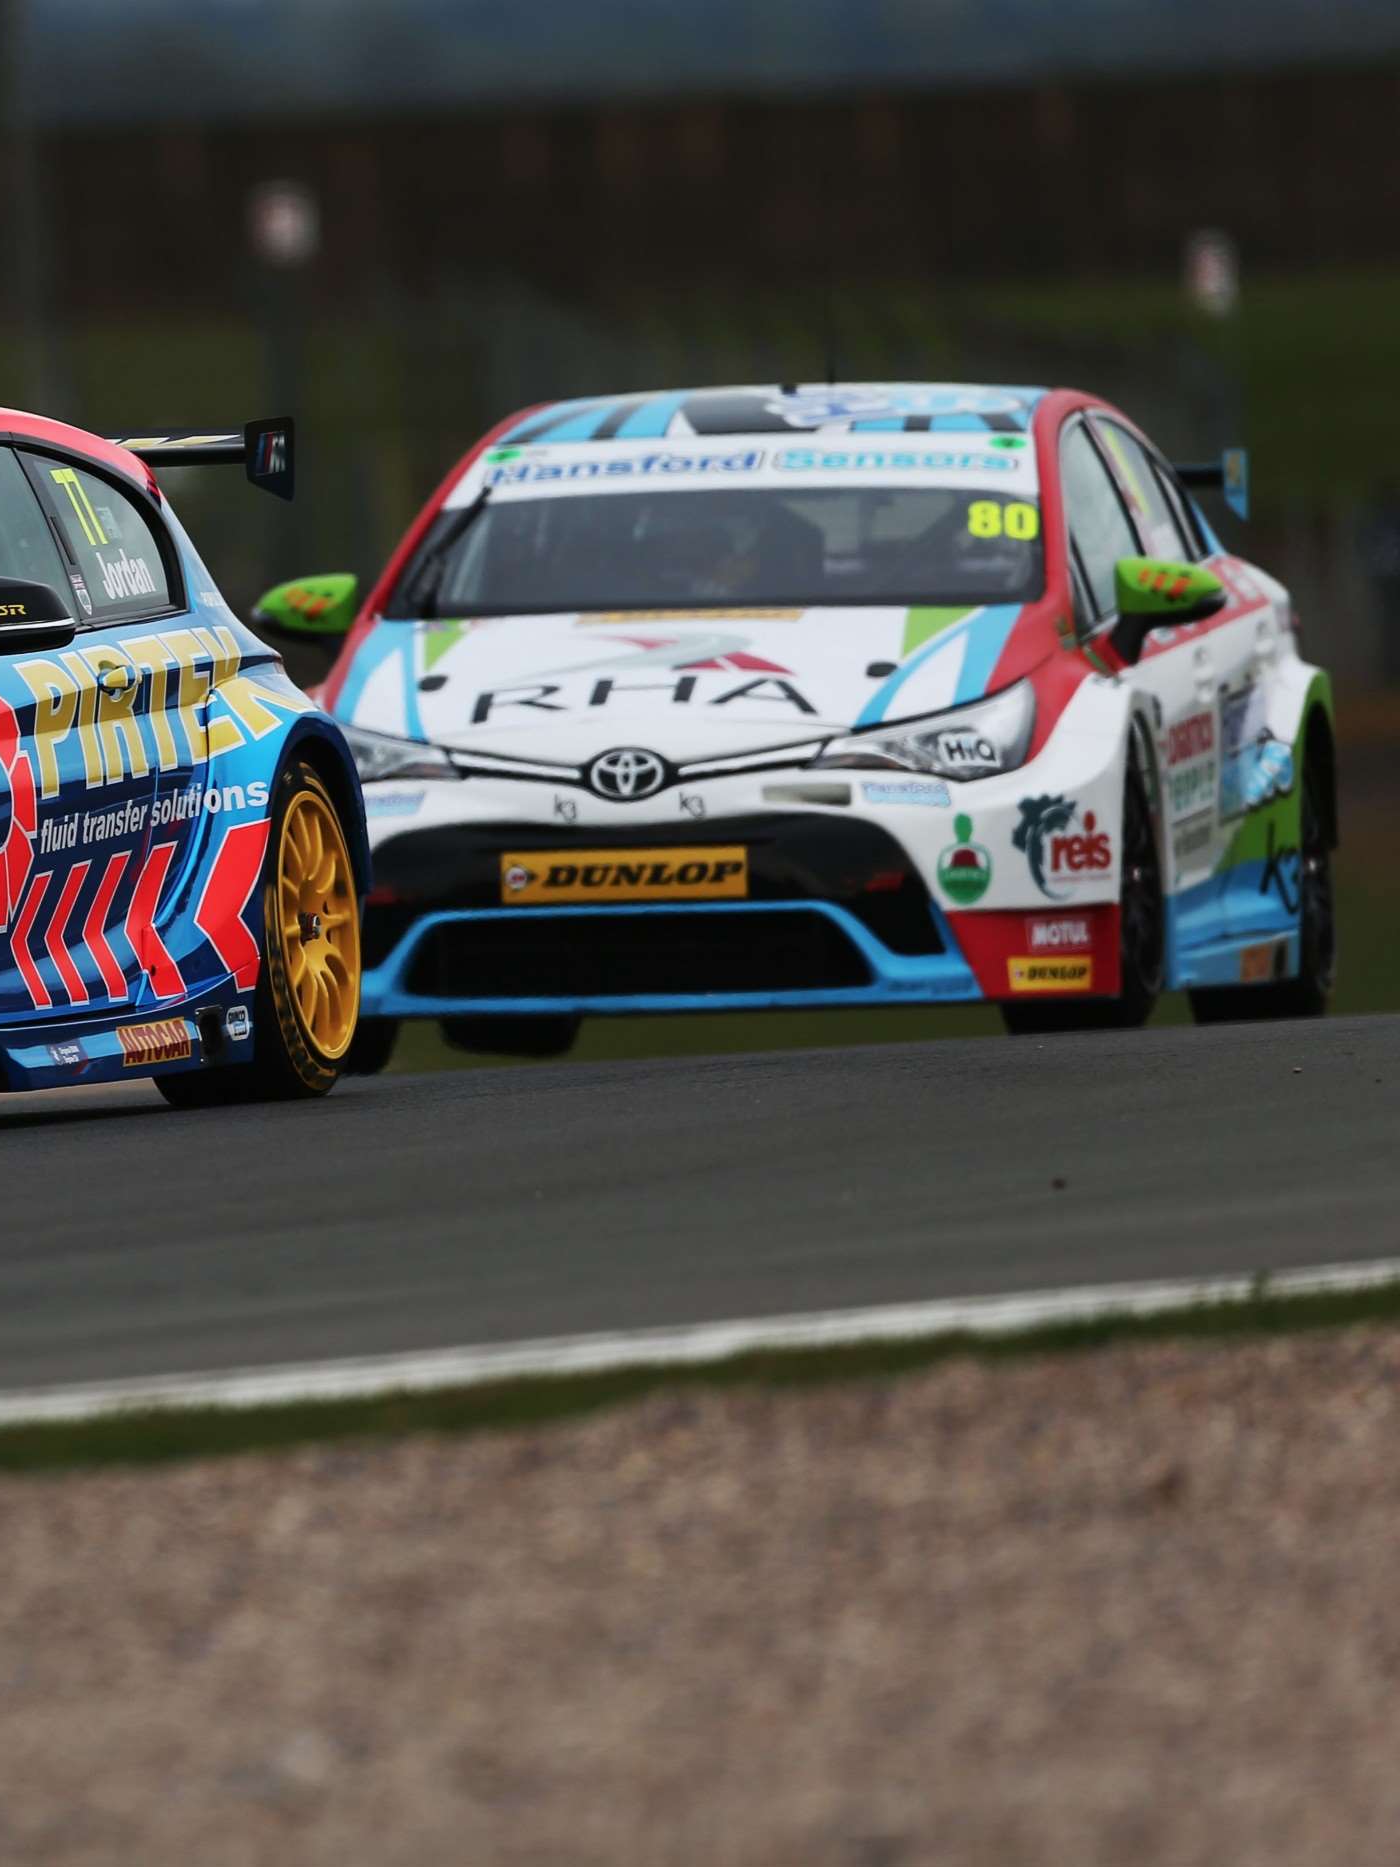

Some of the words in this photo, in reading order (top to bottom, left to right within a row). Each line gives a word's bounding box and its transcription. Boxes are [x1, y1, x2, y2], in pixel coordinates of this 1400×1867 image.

[49, 467, 109, 545] 77
[968, 501, 1039, 541] 80
[95, 548, 157, 600] Jordan
[12, 626, 319, 800] PIRTEK
[470, 676, 819, 725] RHA
[945, 738, 996, 764] HiQ
[40, 816, 78, 855] fluid
[82, 799, 149, 845] transfer
[150, 780, 270, 828] solutions
[1051, 810, 1113, 872] reis
[542, 861, 743, 889] DUNLOP
[1031, 921, 1091, 946] MOTUL
[118, 1018, 191, 1065] AUTOCAR
